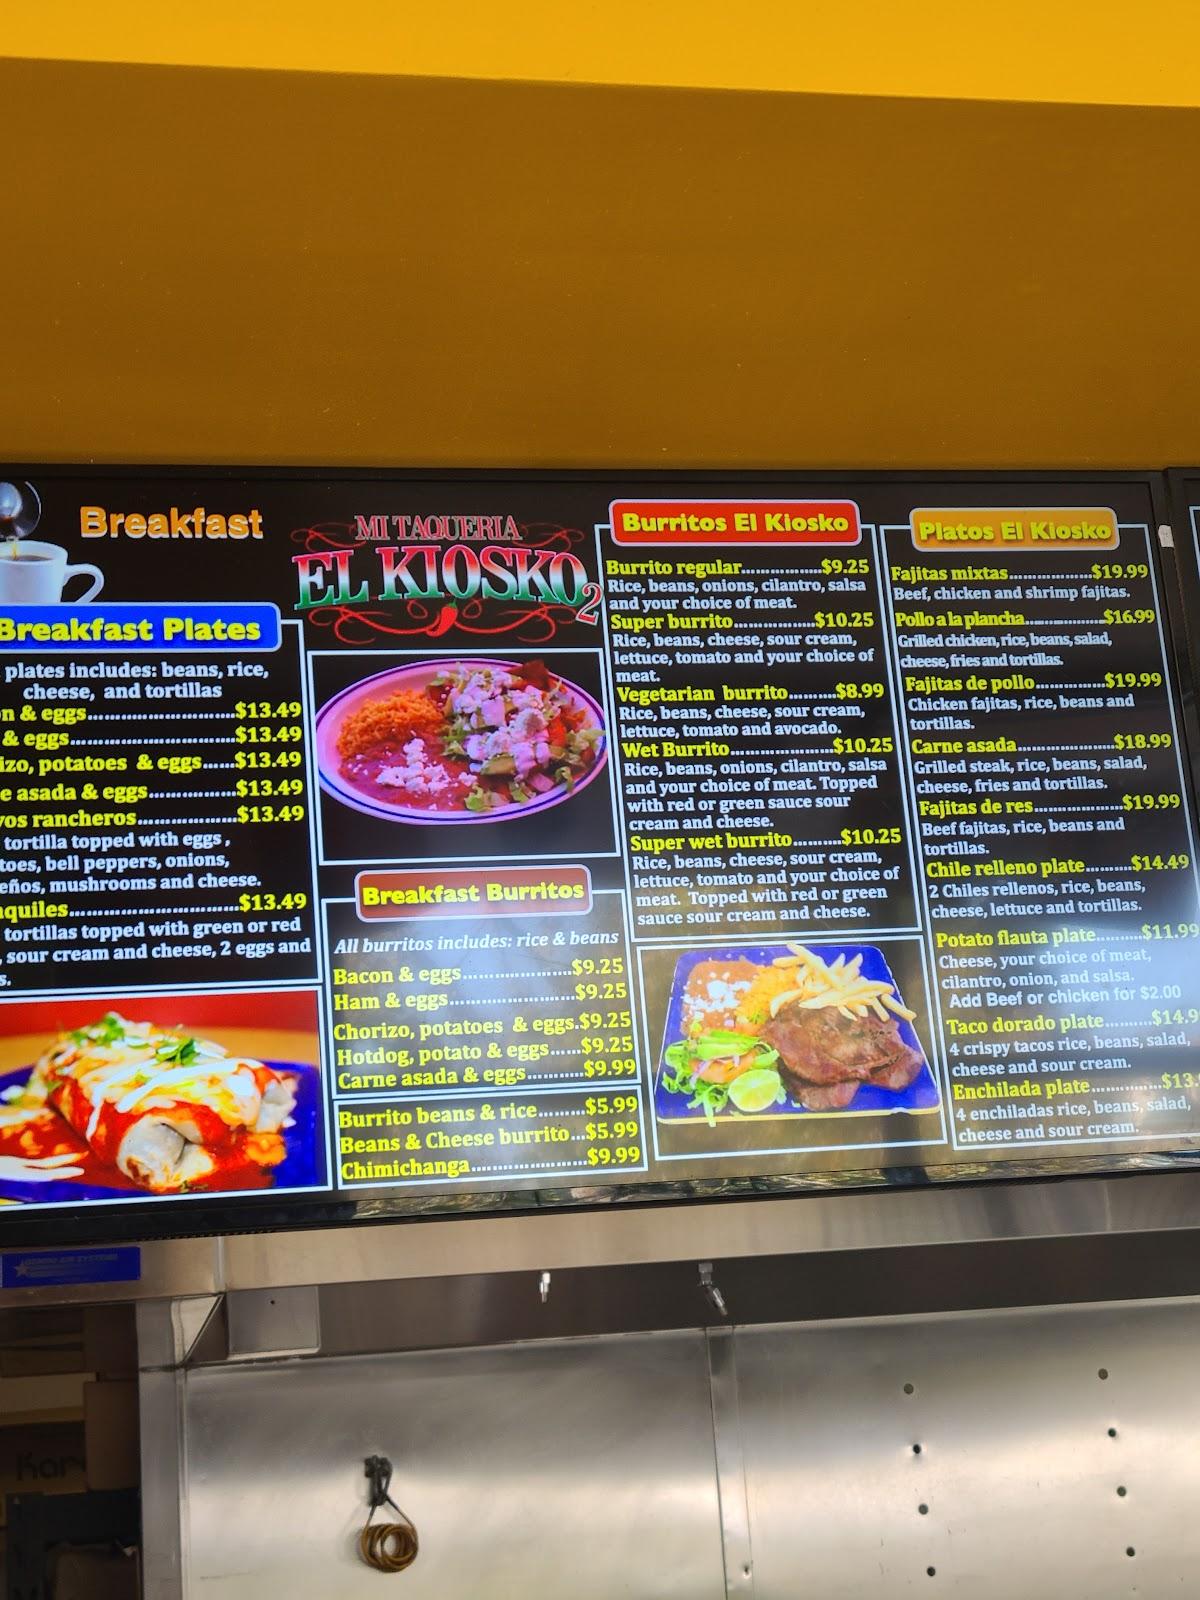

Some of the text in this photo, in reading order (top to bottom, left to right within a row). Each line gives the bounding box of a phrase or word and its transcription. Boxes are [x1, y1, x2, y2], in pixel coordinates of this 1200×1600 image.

[80, 506, 263, 539] Breakfast
[354, 515, 523, 540] MI TAQUERIA
[622, 512, 848, 532] Burritos El Kiosko
[919, 520, 1112, 541] Platos El Kiosko
[606, 560, 672, 575] Burrito
[821, 559, 869, 575] $9.25
[891, 566, 948, 584] Fajitas
[1091, 564, 1148, 579] $19.99
[292, 544, 603, 625] EL KIOSKO 2
[608, 578, 866, 594] Rice, beans, onions, cilantro, salsa
[893, 585, 1130, 602] Beef, chicken and shrimp fajitas.
[0, 618, 260, 642] Breakfast Plates
[611, 614, 665, 633] Super
[814, 612, 874, 628] $10.25
[614, 648, 874, 666] lettuce, tomato and your choice of
[5, 661, 269, 682] plates includes: beans, rice,
[23, 682, 222, 701] cheese, and tortillas
[905, 676, 963, 695] Fajitas
[966, 676, 988, 691] de
[1104, 672, 1162, 688] $19.99
[617, 686, 714, 706] Vegetarian
[836, 683, 884, 699] $8.99
[20, 705, 37, 722] &
[234, 702, 301, 719] $13.49
[620, 720, 842, 739] lettuce, tomato and avocado.
[623, 742, 660, 758] Wet
[833, 737, 893, 755] $10.25
[912, 739, 964, 754] Carne
[1114, 734, 1172, 750] $18.99
[0, 756, 34, 775] izo,
[39, 756, 128, 776] potatoes
[136, 756, 153, 770] &
[234, 752, 301, 769] $13.49
[914, 756, 1148, 774] Grilled steak, rice, beans, salad,
[236, 806, 304, 823] $13.49
[627, 795, 851, 813] with red or green sauce sour
[0, 854, 230, 873] toes, bell peppers, onions,
[927, 862, 970, 878] Chile
[975, 860, 1037, 875] relleno
[1131, 854, 1190, 872] $14.49
[0, 874, 261, 894] eños, mushrooms and cheese.
[363, 882, 584, 905] Breakfast Burritos
[239, 893, 306, 912] $13.49
[334, 930, 619, 954] All burritos includes: rice & beans
[936, 932, 994, 948] Potato
[998, 930, 1048, 945] flauta
[6, 938, 311, 964] sour cream and cheese, 2 eggs and
[334, 968, 393, 985] Bacon
[399, 967, 414, 981] &
[571, 958, 624, 977] $9.25
[942, 969, 1134, 990] cilantro, onion, and salsa.
[949, 985, 1181, 1009] Add Beef or chicken for $2.00
[338, 1047, 415, 1067] Hotdog,
[419, 1045, 481, 1064] potato
[487, 1043, 502, 1058] &
[580, 1036, 633, 1055] $9.25
[950, 1032, 1191, 1057] 4 crispy tacos rice, beans, salad,
[953, 1080, 1042, 1100] Enchilada
[1162, 1073, 1200, 1089] $13.
[339, 1108, 412, 1128] Burrito
[417, 1106, 475, 1124] beans
[480, 1105, 495, 1121] &
[585, 1097, 638, 1116] $5.99
[587, 1146, 640, 1166] $9.99
